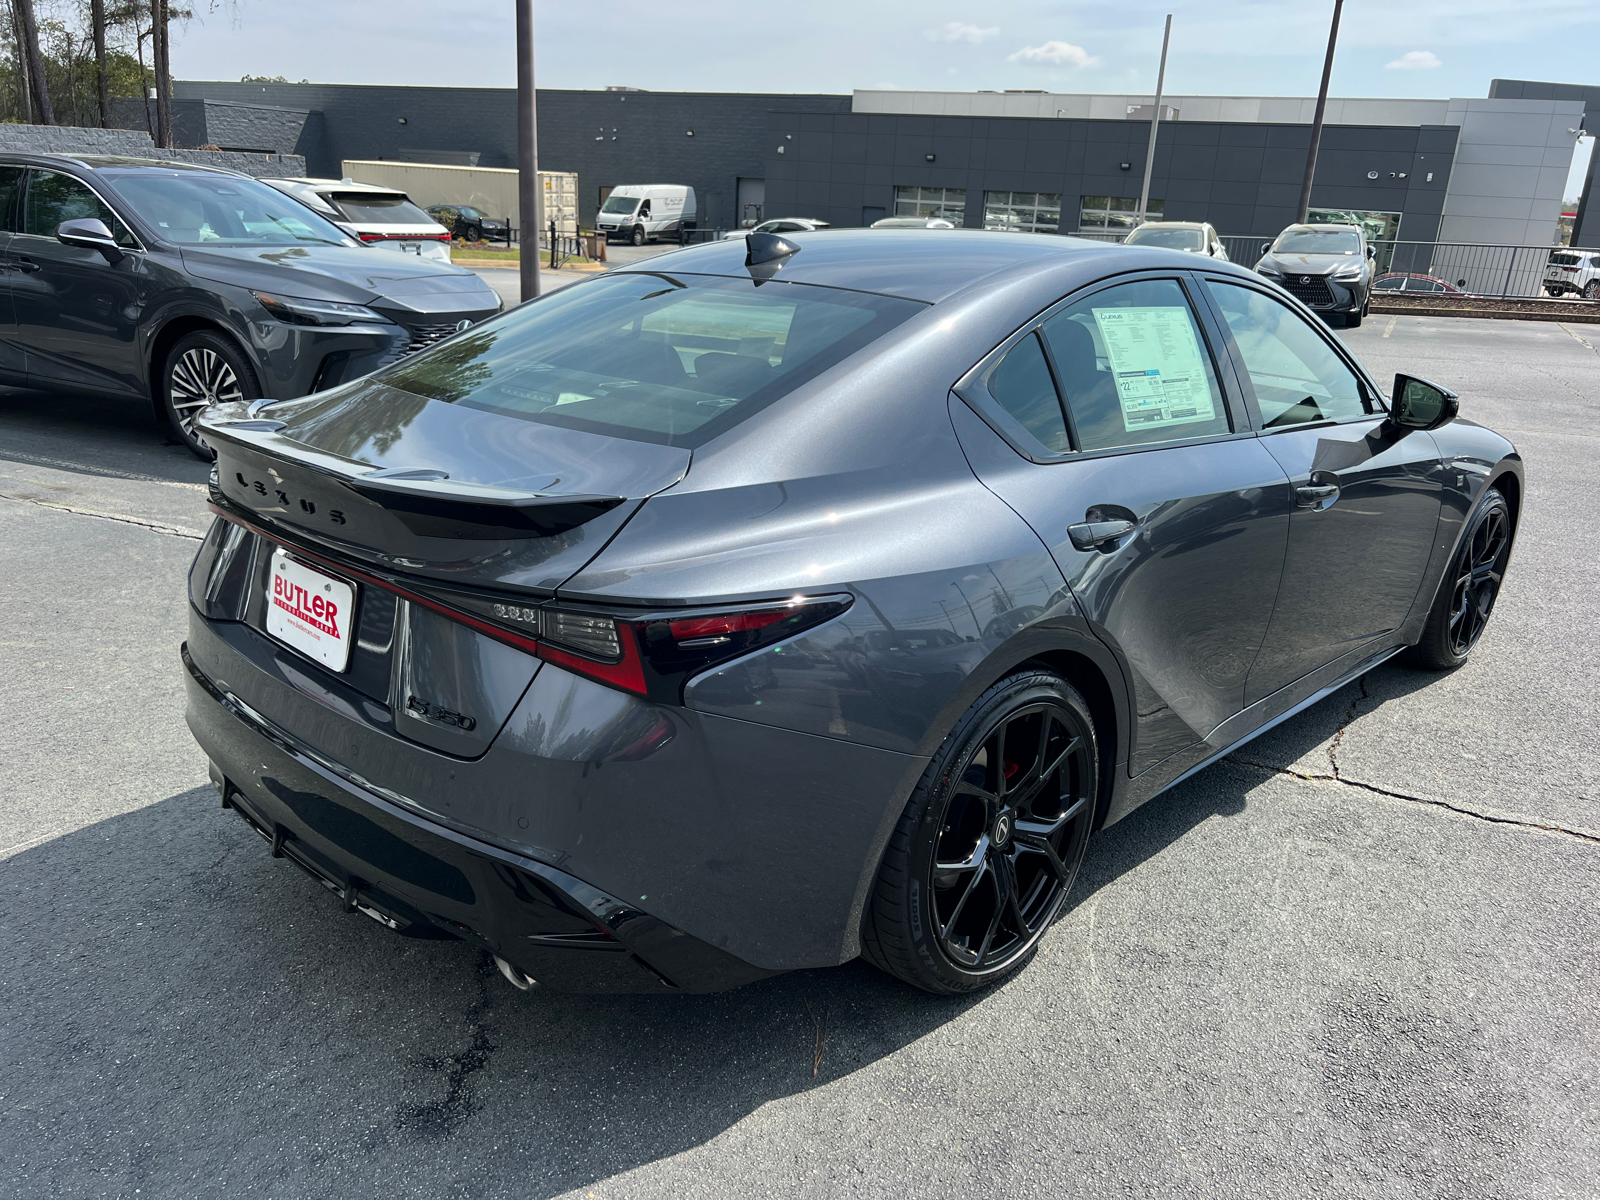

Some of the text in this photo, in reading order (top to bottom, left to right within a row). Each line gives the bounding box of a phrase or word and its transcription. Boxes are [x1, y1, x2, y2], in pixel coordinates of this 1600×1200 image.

[235, 472, 347, 526] LEXUS
[315, 621, 340, 638] GROUP
[918, 943, 975, 990] POTENZA
